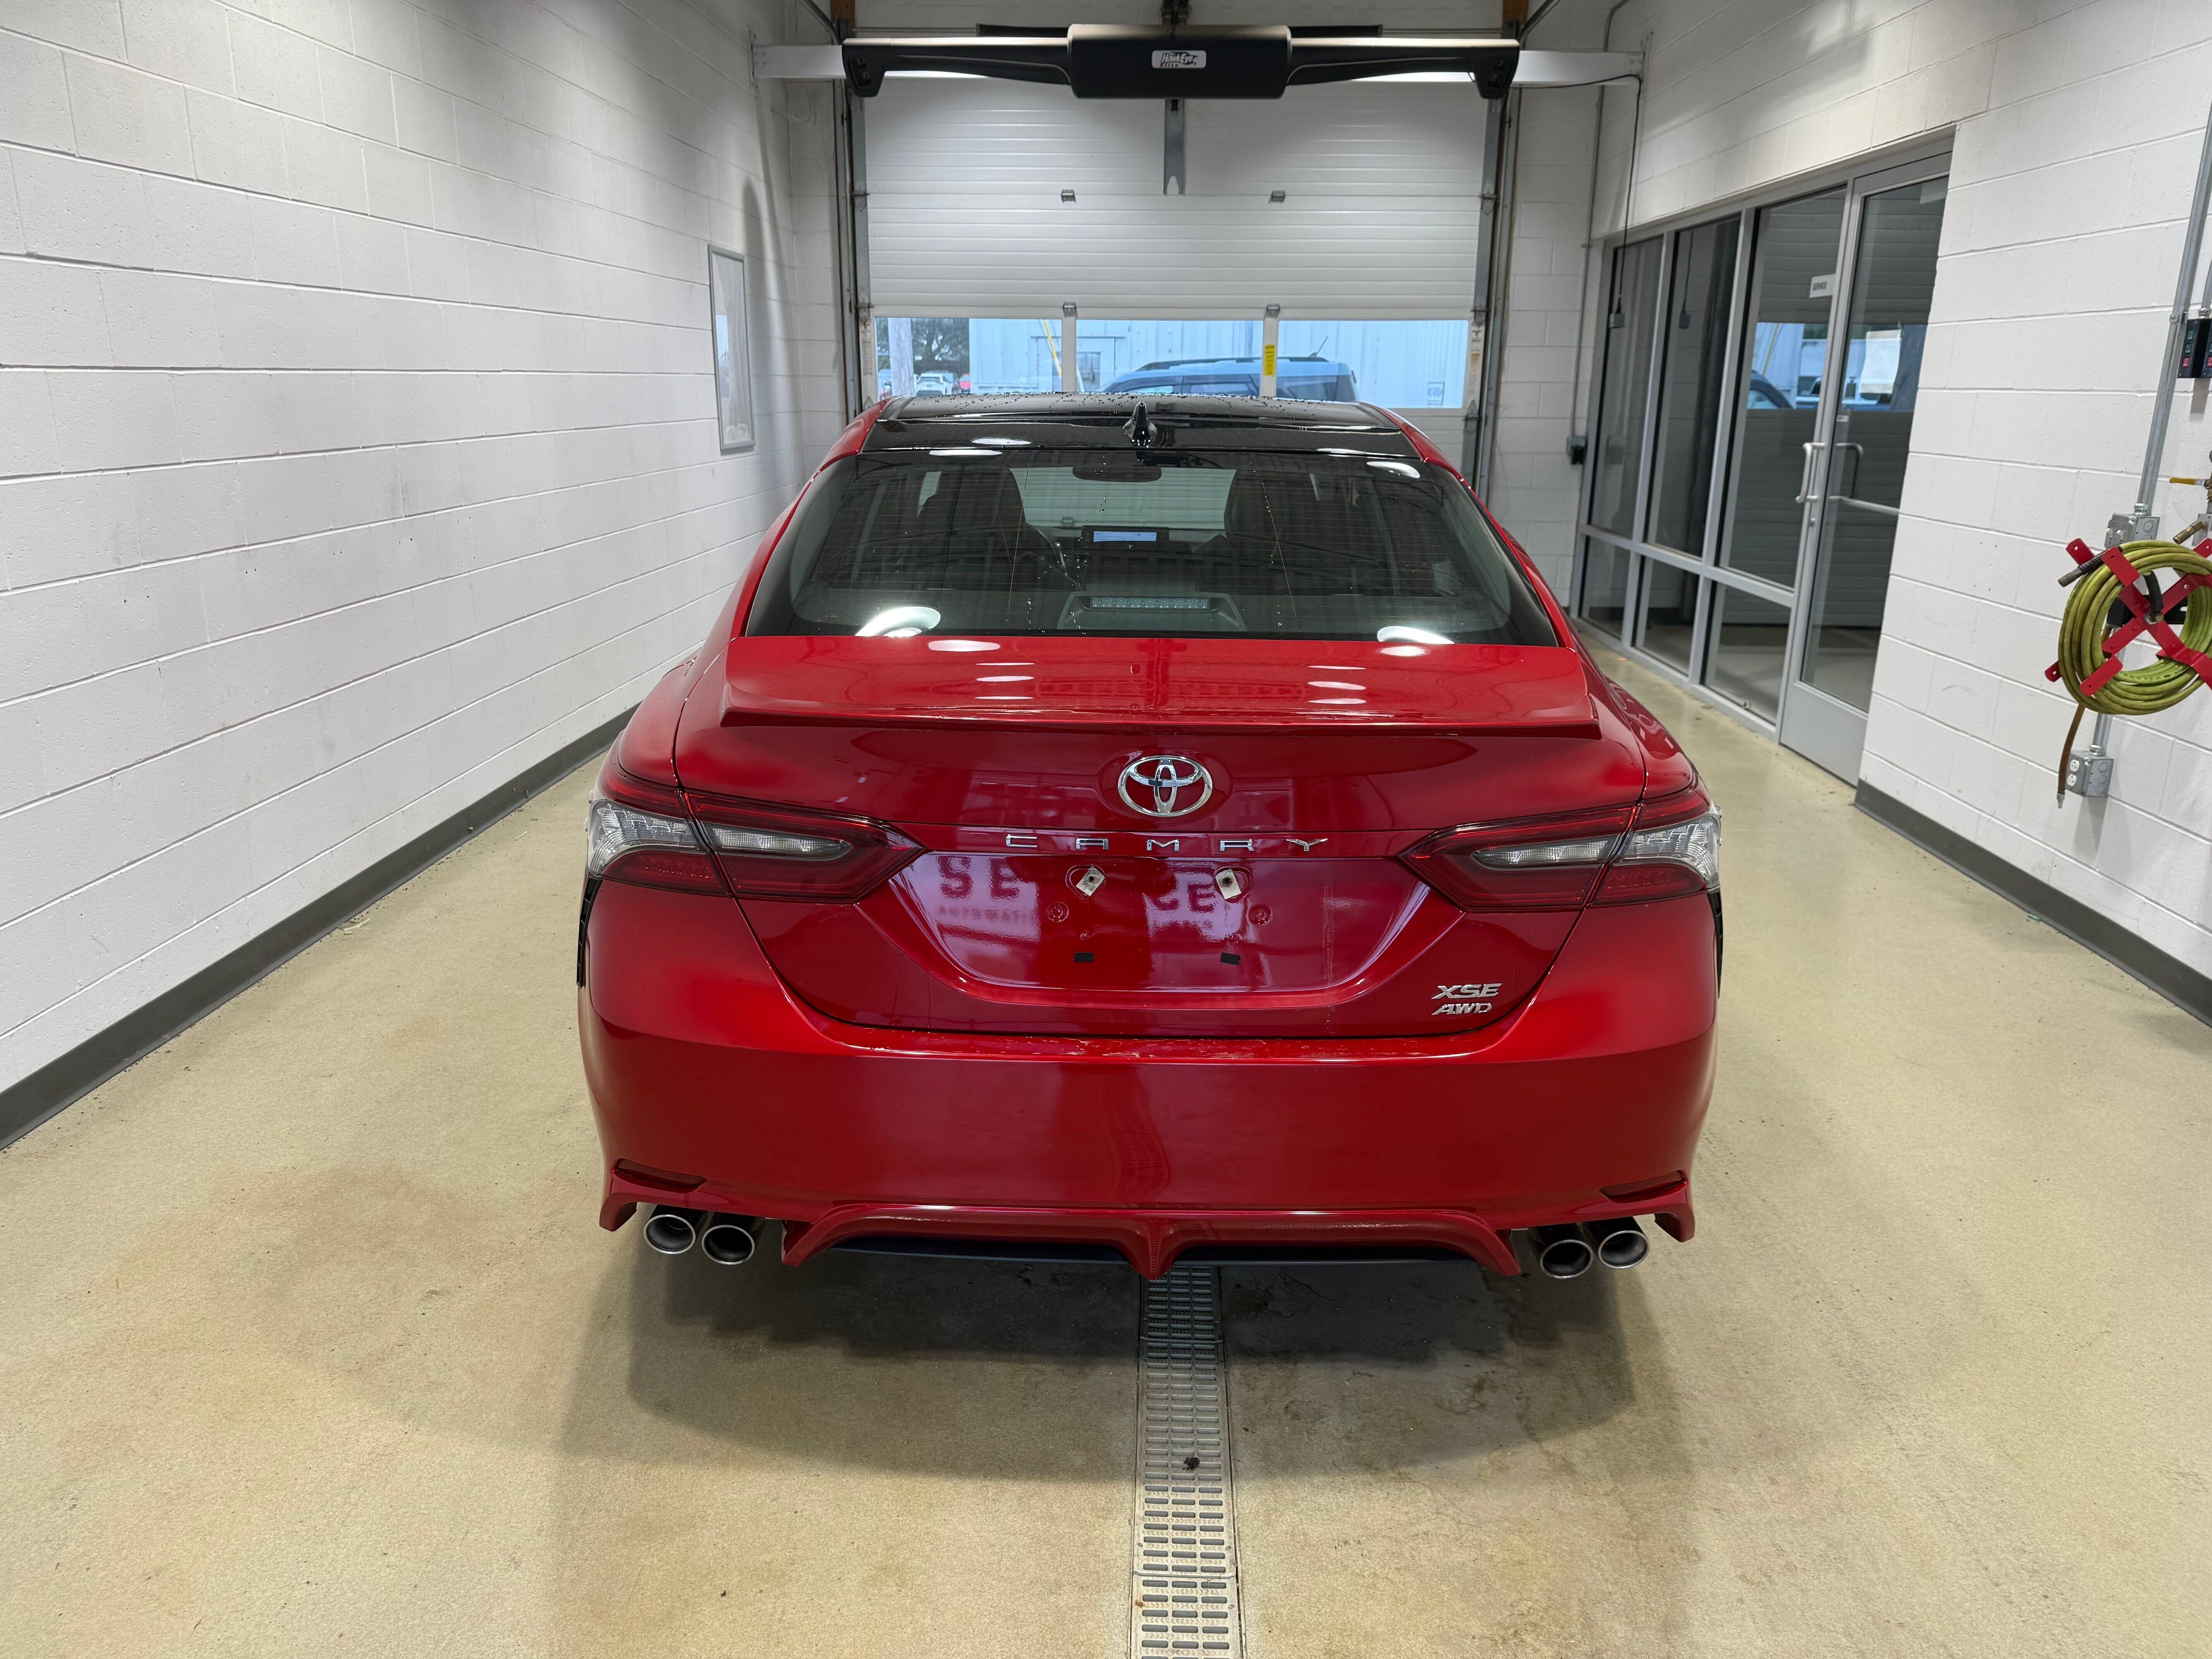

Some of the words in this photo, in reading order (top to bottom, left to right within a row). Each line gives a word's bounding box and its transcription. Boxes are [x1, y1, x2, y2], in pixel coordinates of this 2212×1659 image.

[1161, 53, 1194, 64] HawkEye
[1006, 834, 1328, 852] CAMRY
[1431, 983, 1502, 999] XSE
[1431, 1003, 1492, 1016] AWD
